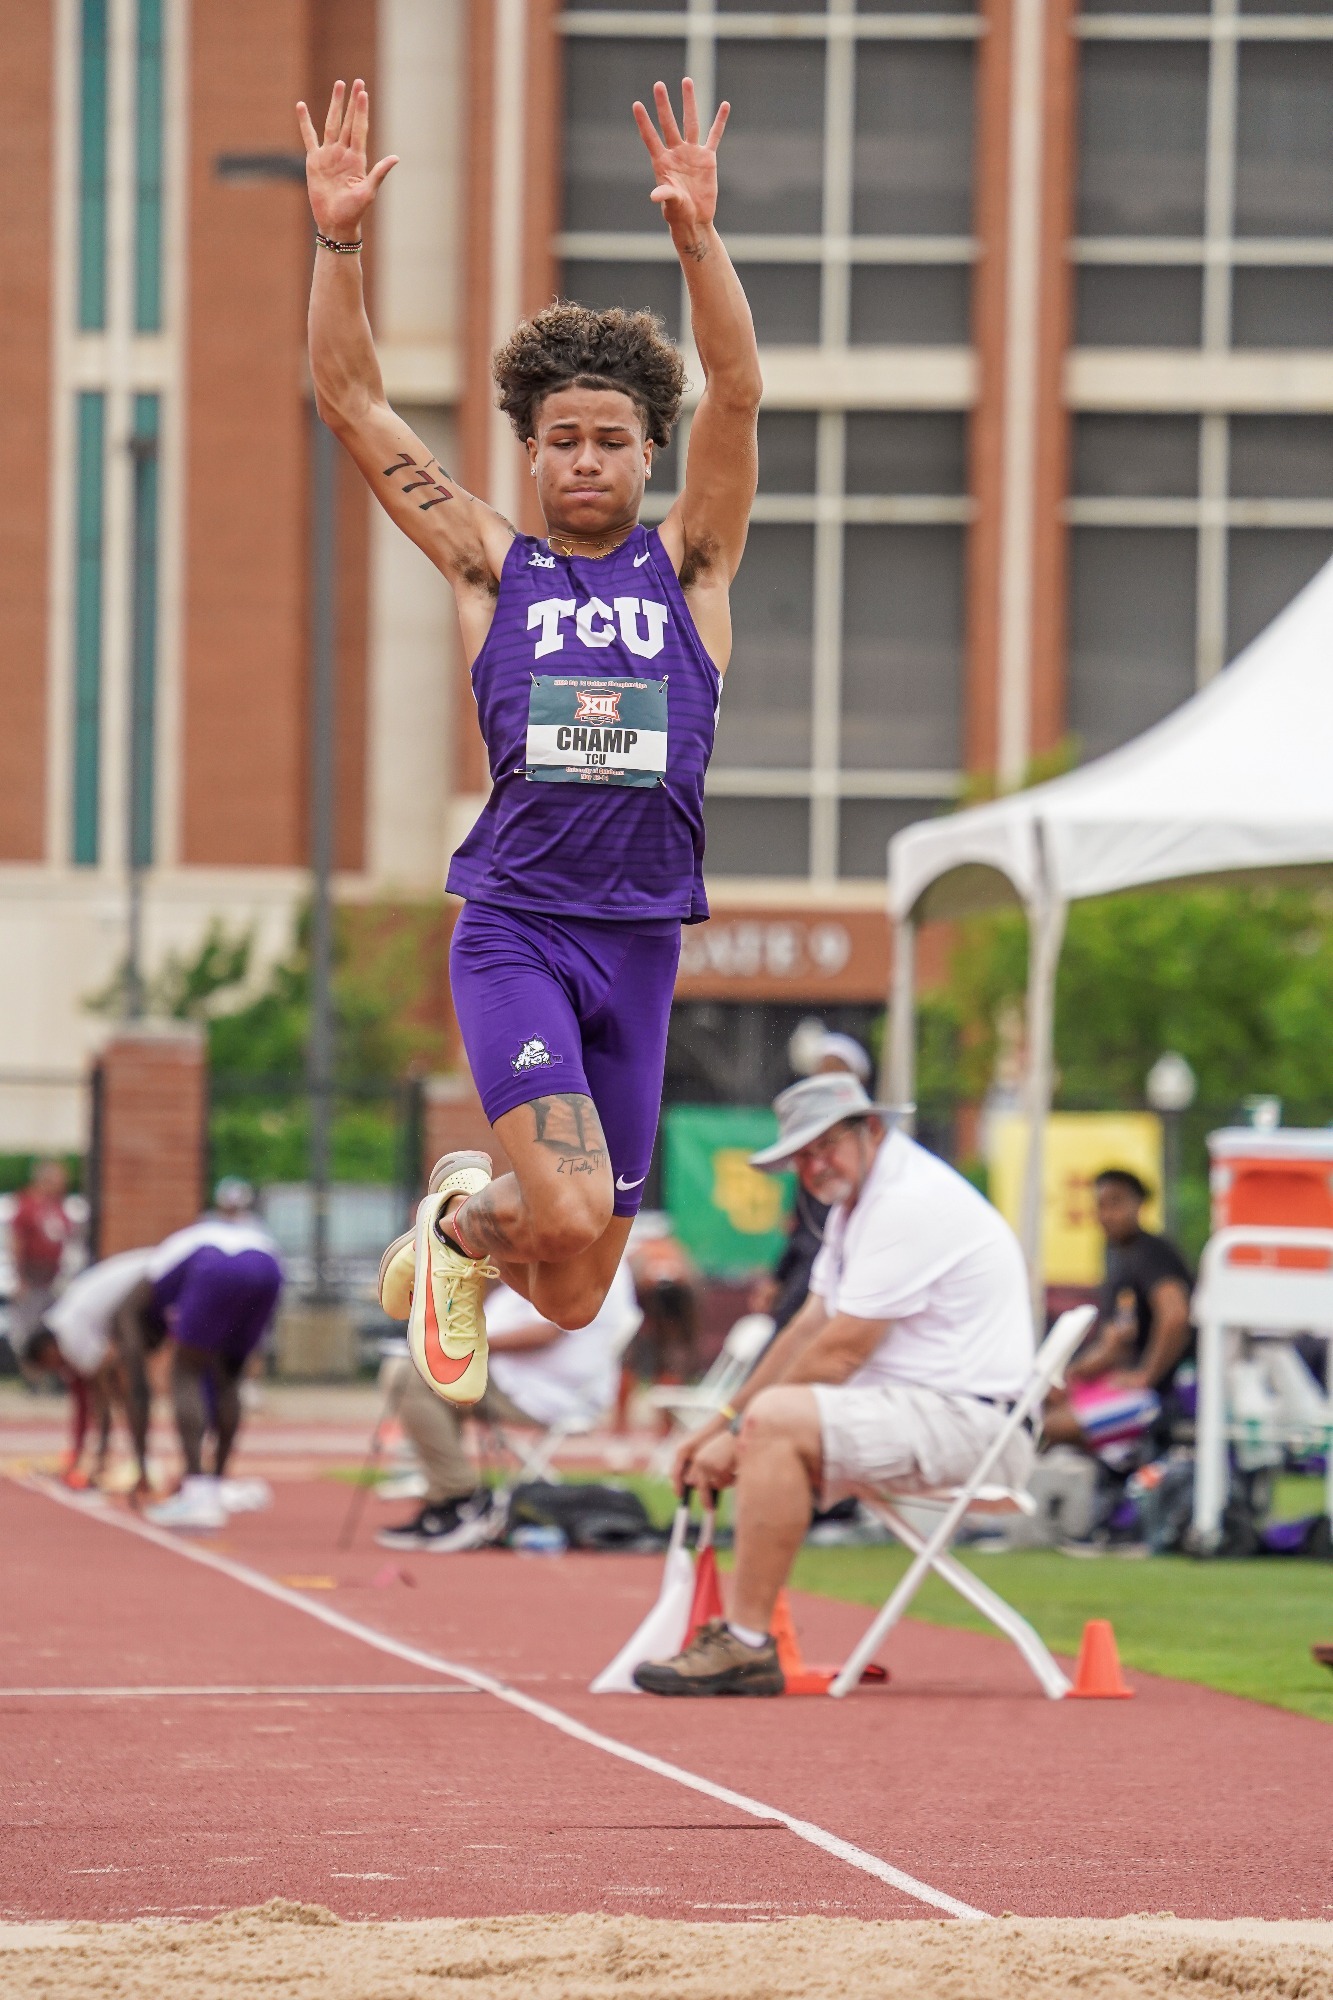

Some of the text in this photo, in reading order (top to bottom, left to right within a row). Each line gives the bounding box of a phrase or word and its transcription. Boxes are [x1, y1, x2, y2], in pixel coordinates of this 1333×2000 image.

[383, 454, 453, 511] 777
[527, 597, 668, 660] TCU
[578, 695, 619, 718] XII
[556, 727, 638, 754] CHAMP
[585, 753, 606, 766] TCU
